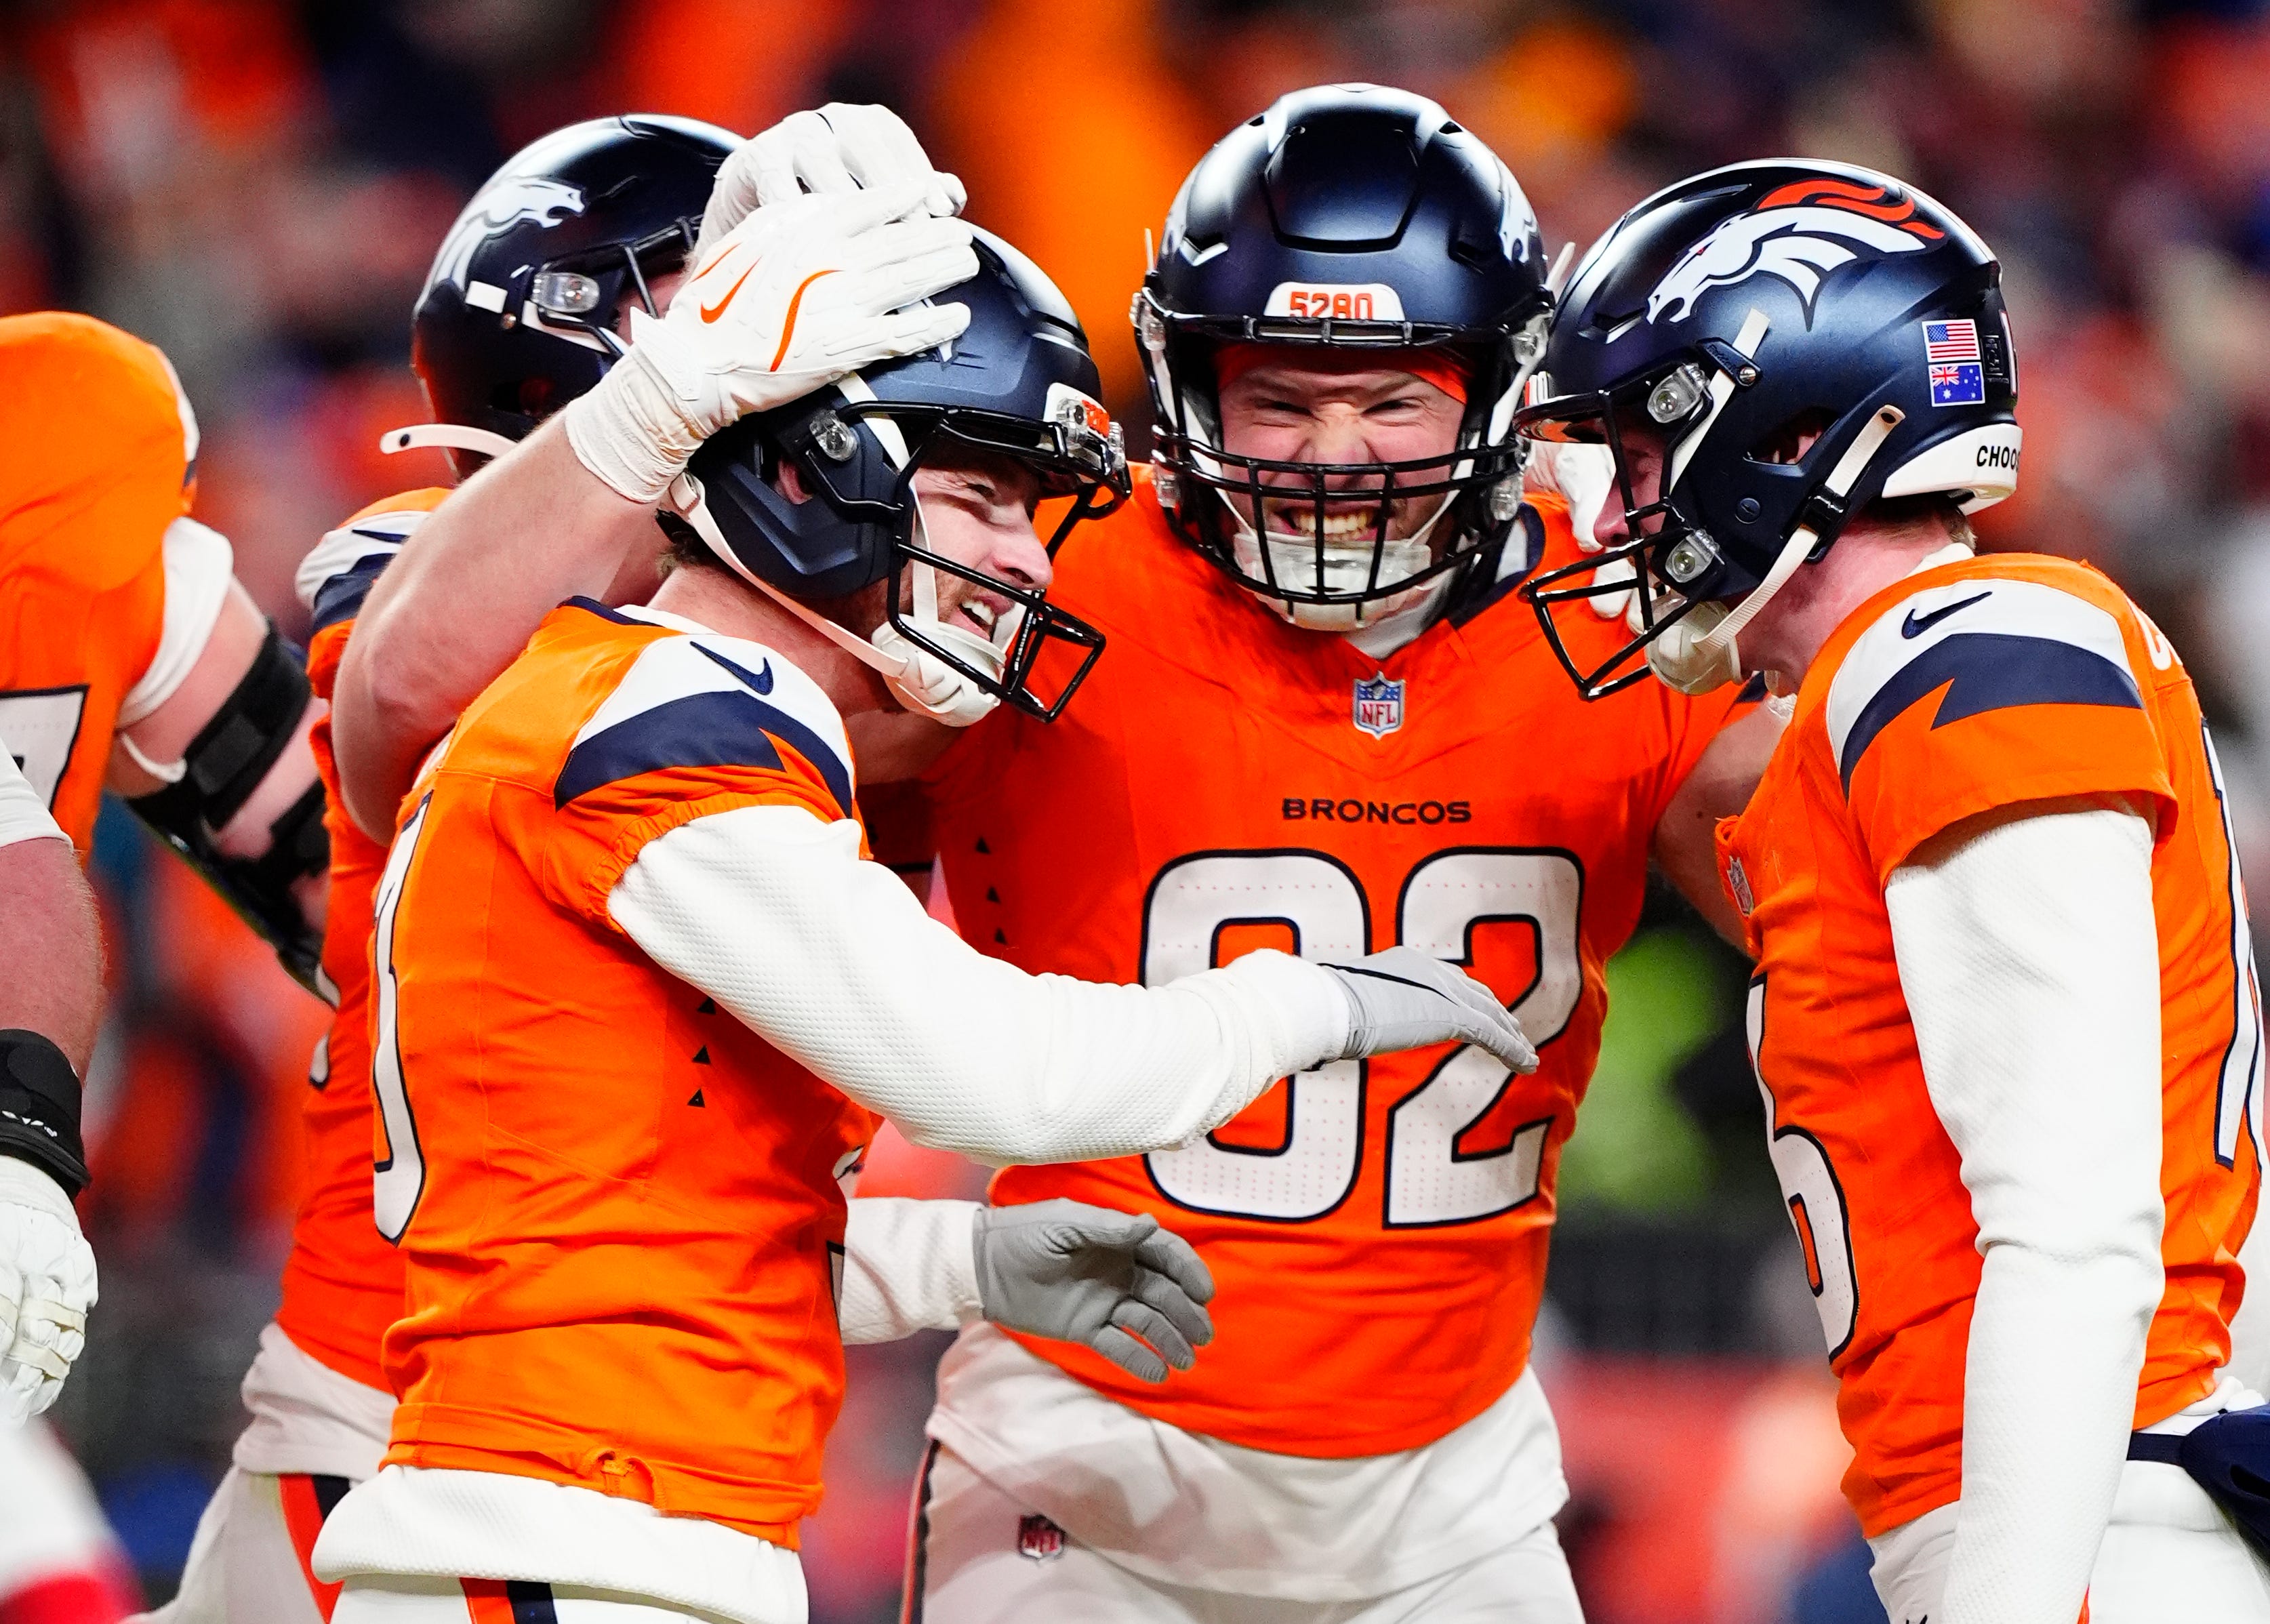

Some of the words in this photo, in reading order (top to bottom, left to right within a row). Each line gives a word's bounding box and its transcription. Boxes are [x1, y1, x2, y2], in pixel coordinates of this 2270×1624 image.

[1290, 291, 1373, 320] 5280
[1362, 703, 1396, 727] NFL
[1282, 798, 1472, 825] BRONCOS
